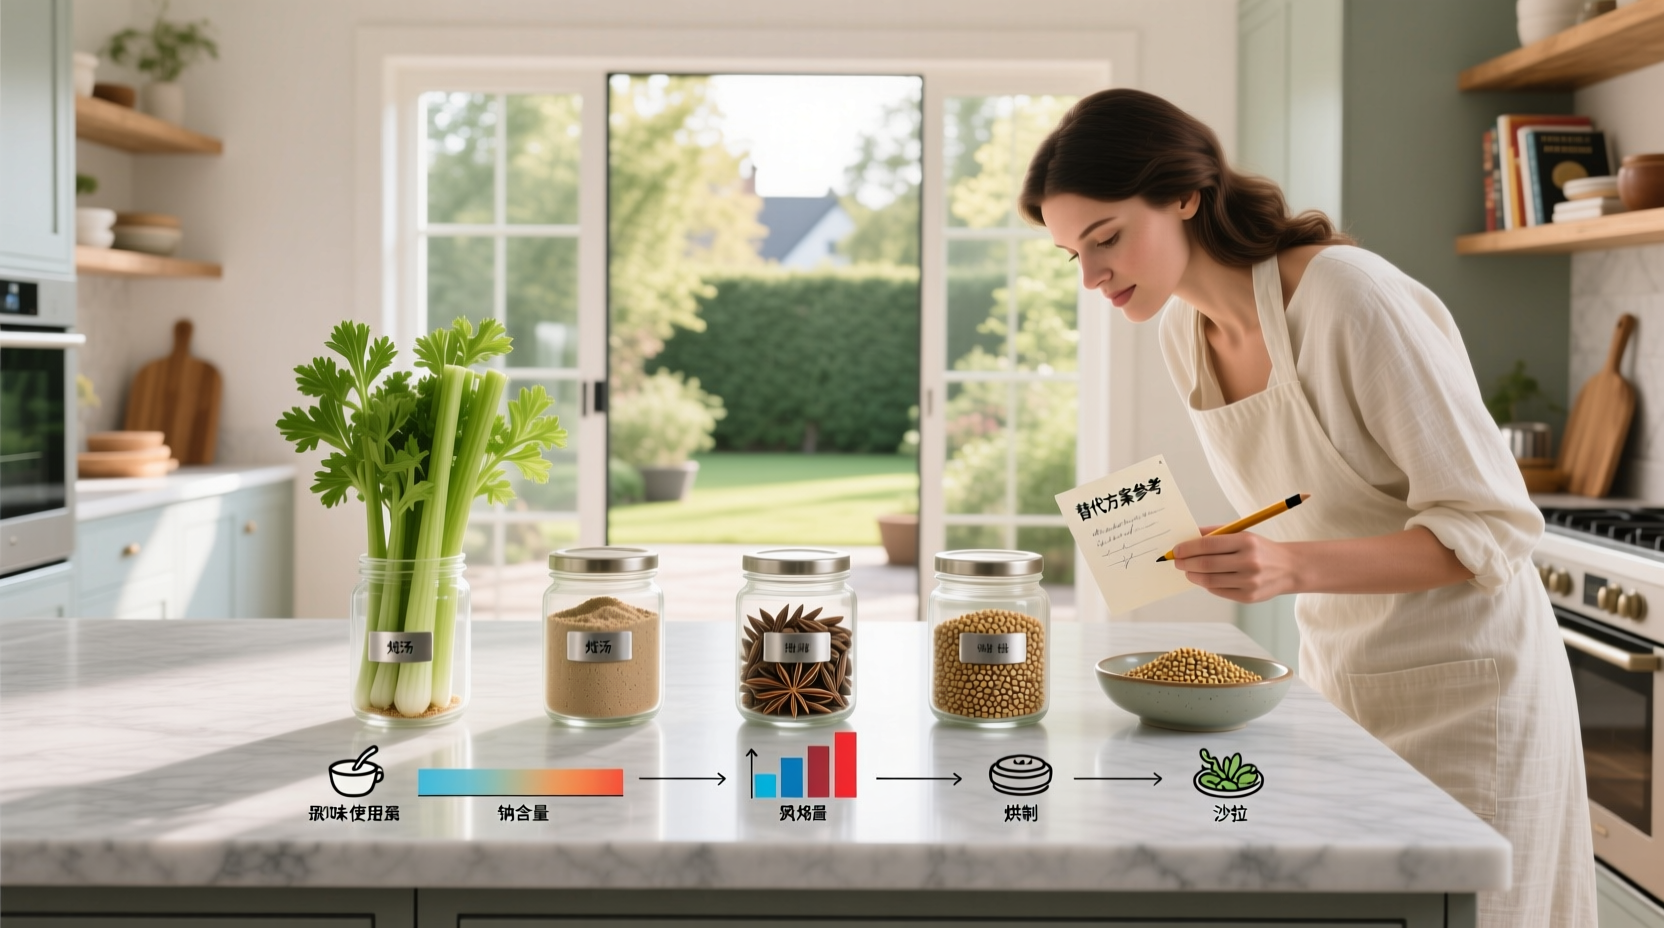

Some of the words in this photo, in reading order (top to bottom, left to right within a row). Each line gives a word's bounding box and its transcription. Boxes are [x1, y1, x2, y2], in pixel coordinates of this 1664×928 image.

[1075, 477, 1161, 521] 替代方案参考
